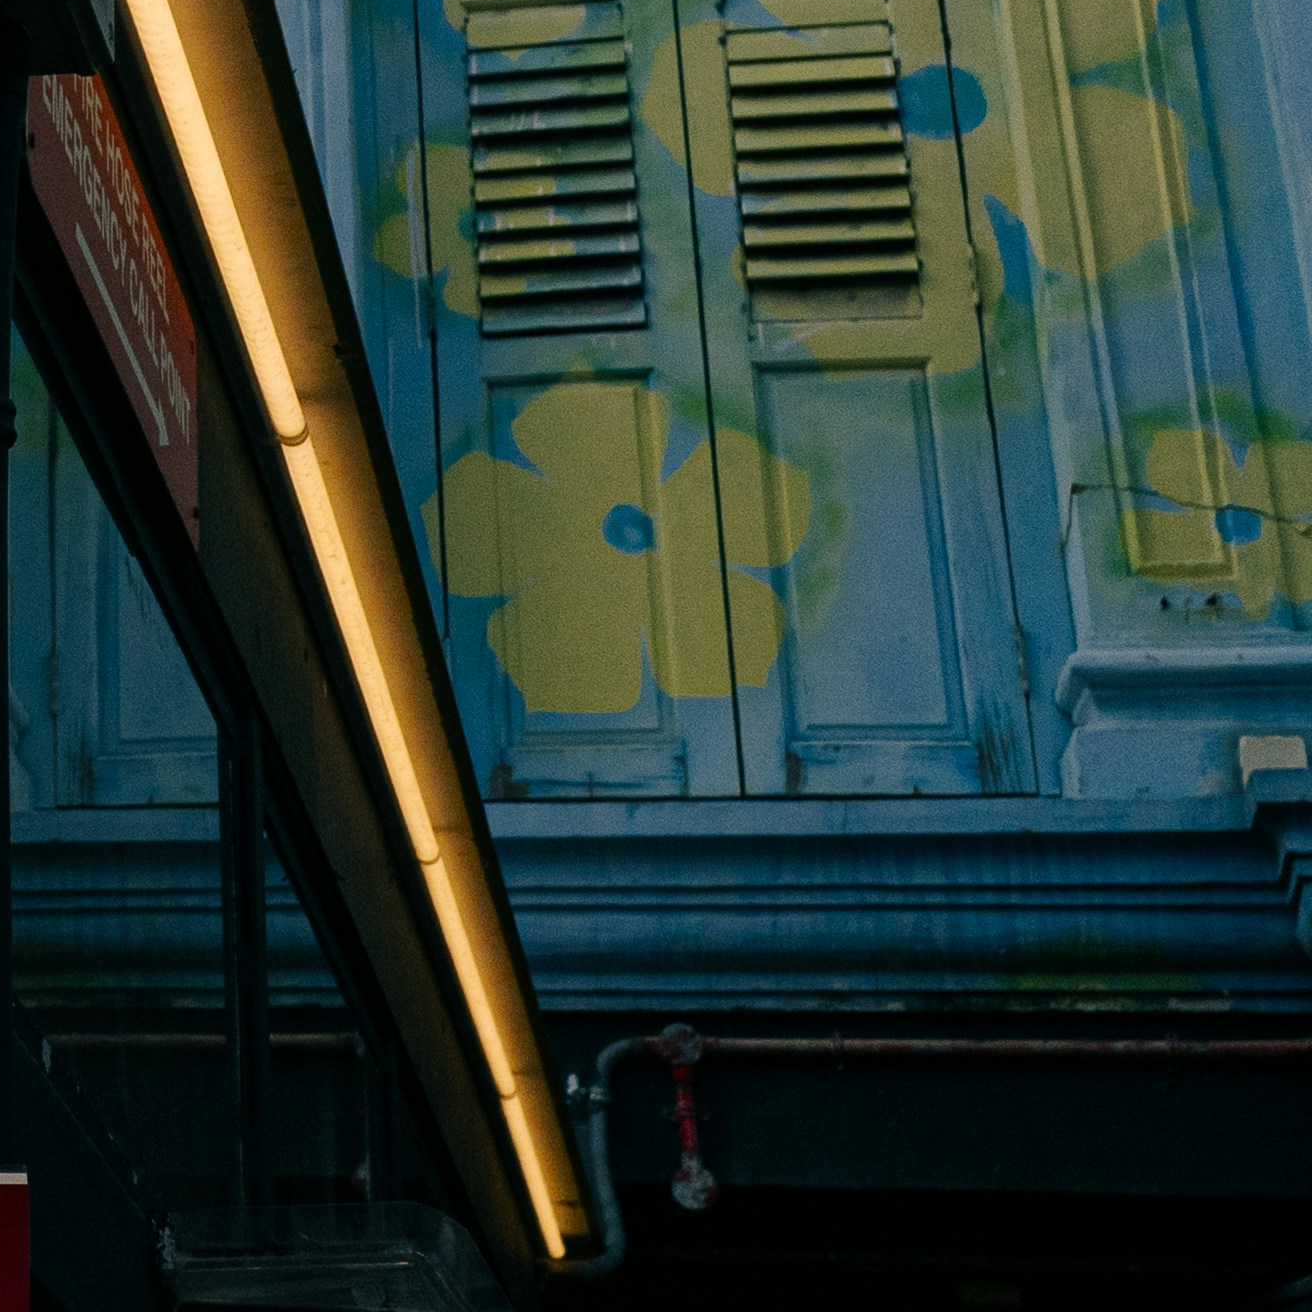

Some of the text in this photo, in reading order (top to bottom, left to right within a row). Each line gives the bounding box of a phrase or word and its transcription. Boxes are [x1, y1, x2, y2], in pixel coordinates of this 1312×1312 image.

[42, 74, 191, 446] EMERGENCY CALL POINT
[106, 120, 140, 247] HOSE
[141, 213, 170, 327] REEL
